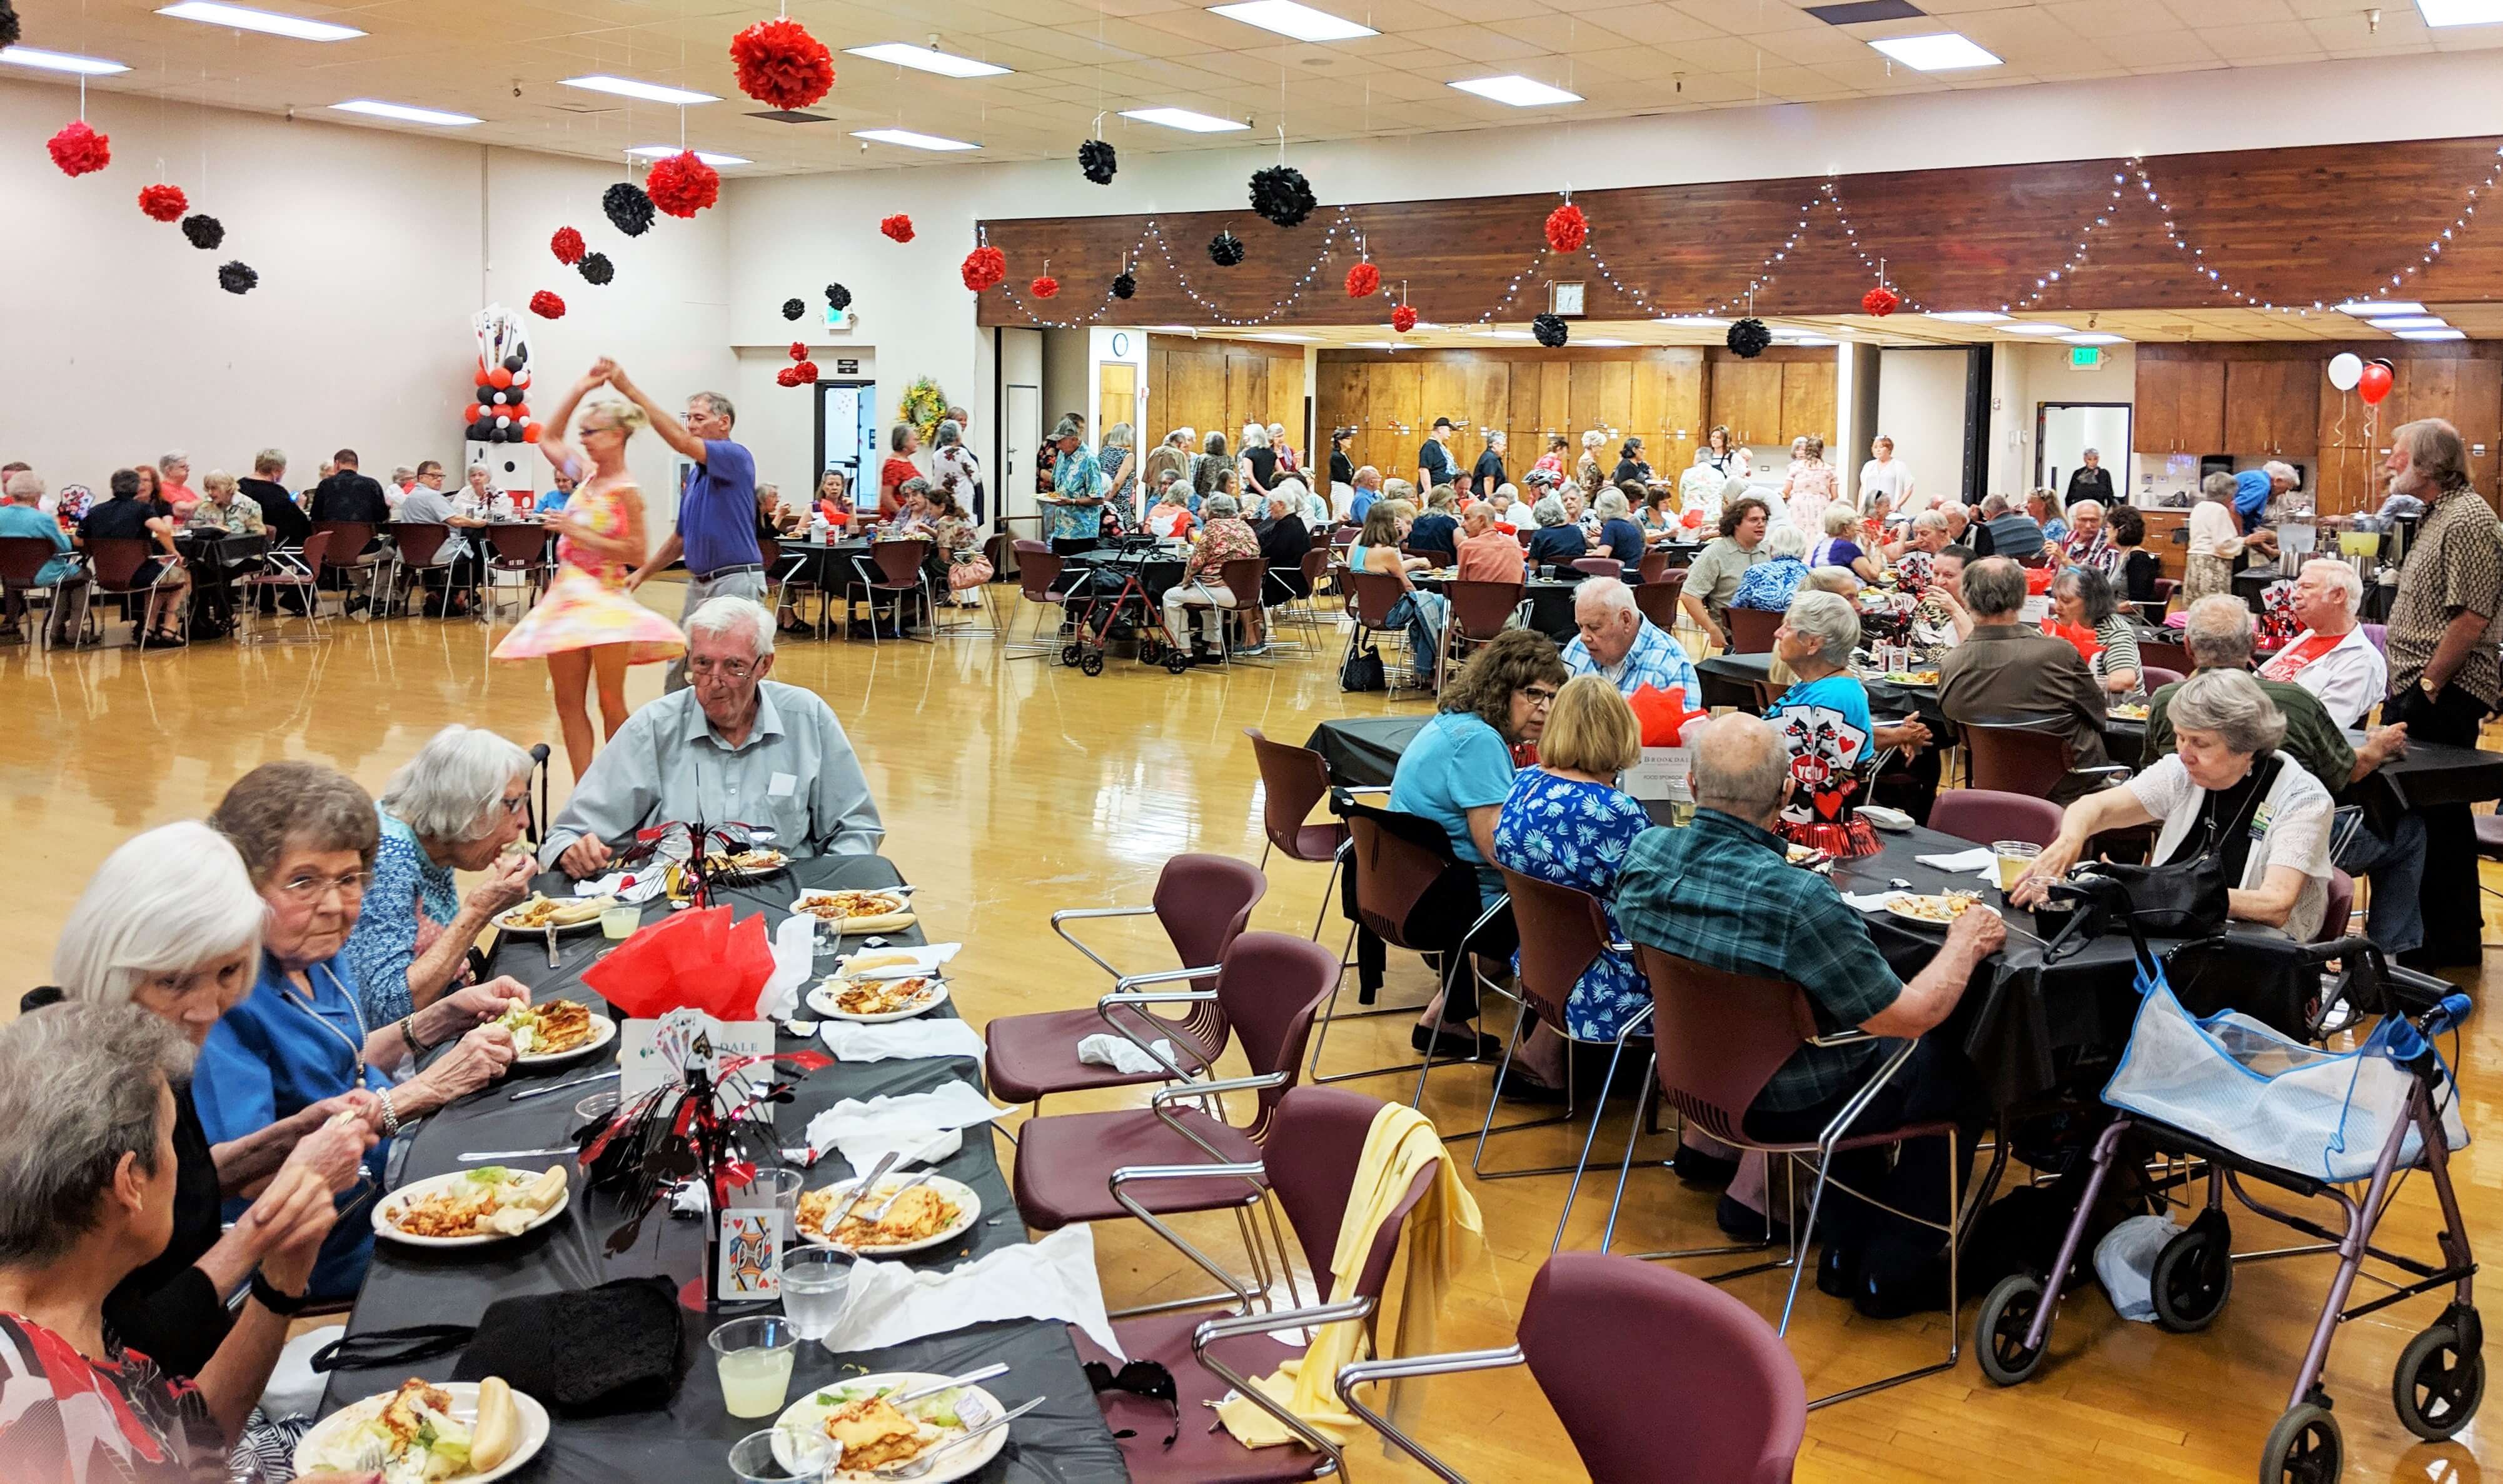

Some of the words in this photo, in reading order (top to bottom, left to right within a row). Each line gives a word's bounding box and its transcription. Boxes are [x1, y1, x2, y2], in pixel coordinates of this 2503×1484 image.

[2075, 348, 2098, 364] EXIT
[1796, 765, 1823, 781] YOU
[720, 1042, 759, 1051] DALE
